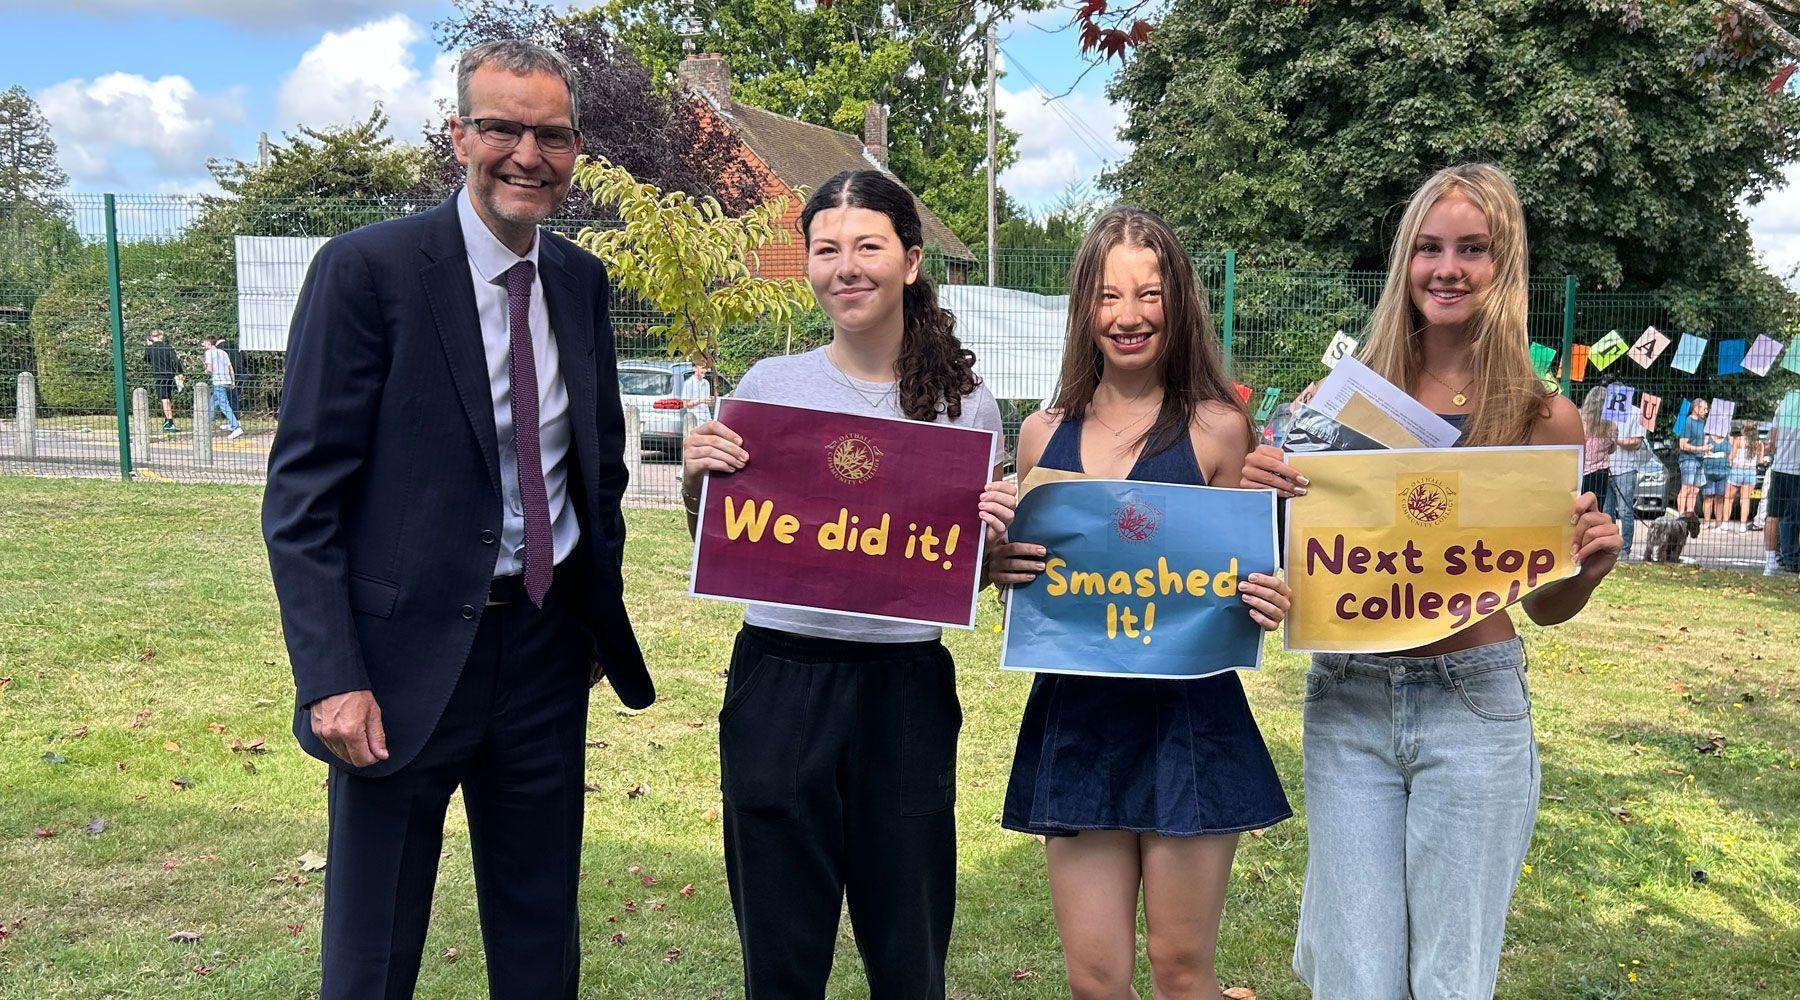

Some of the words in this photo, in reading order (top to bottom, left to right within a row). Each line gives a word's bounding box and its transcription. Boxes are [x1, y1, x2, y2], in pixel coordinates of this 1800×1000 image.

[1331, 341, 1348, 360] S
[1635, 338, 1656, 359] A
[1607, 392, 1627, 412] R
[1642, 400, 1656, 420] U
[838, 433, 871, 444] OATHALL
[827, 452, 857, 485] COMMUNITY
[858, 459, 880, 485] COLLEGE
[1410, 477, 1443, 487] OATHALL
[1401, 498, 1432, 528] COMMUNITY
[1434, 499, 1454, 526] COLLEGE
[725, 496, 800, 544] We
[818, 508, 890, 555] did
[905, 523, 960, 570] it!
[1306, 534, 1424, 576] Next
[1444, 540, 1555, 587] stop
[1045, 556, 1238, 598] Smashed
[1106, 602, 1155, 645] It!
